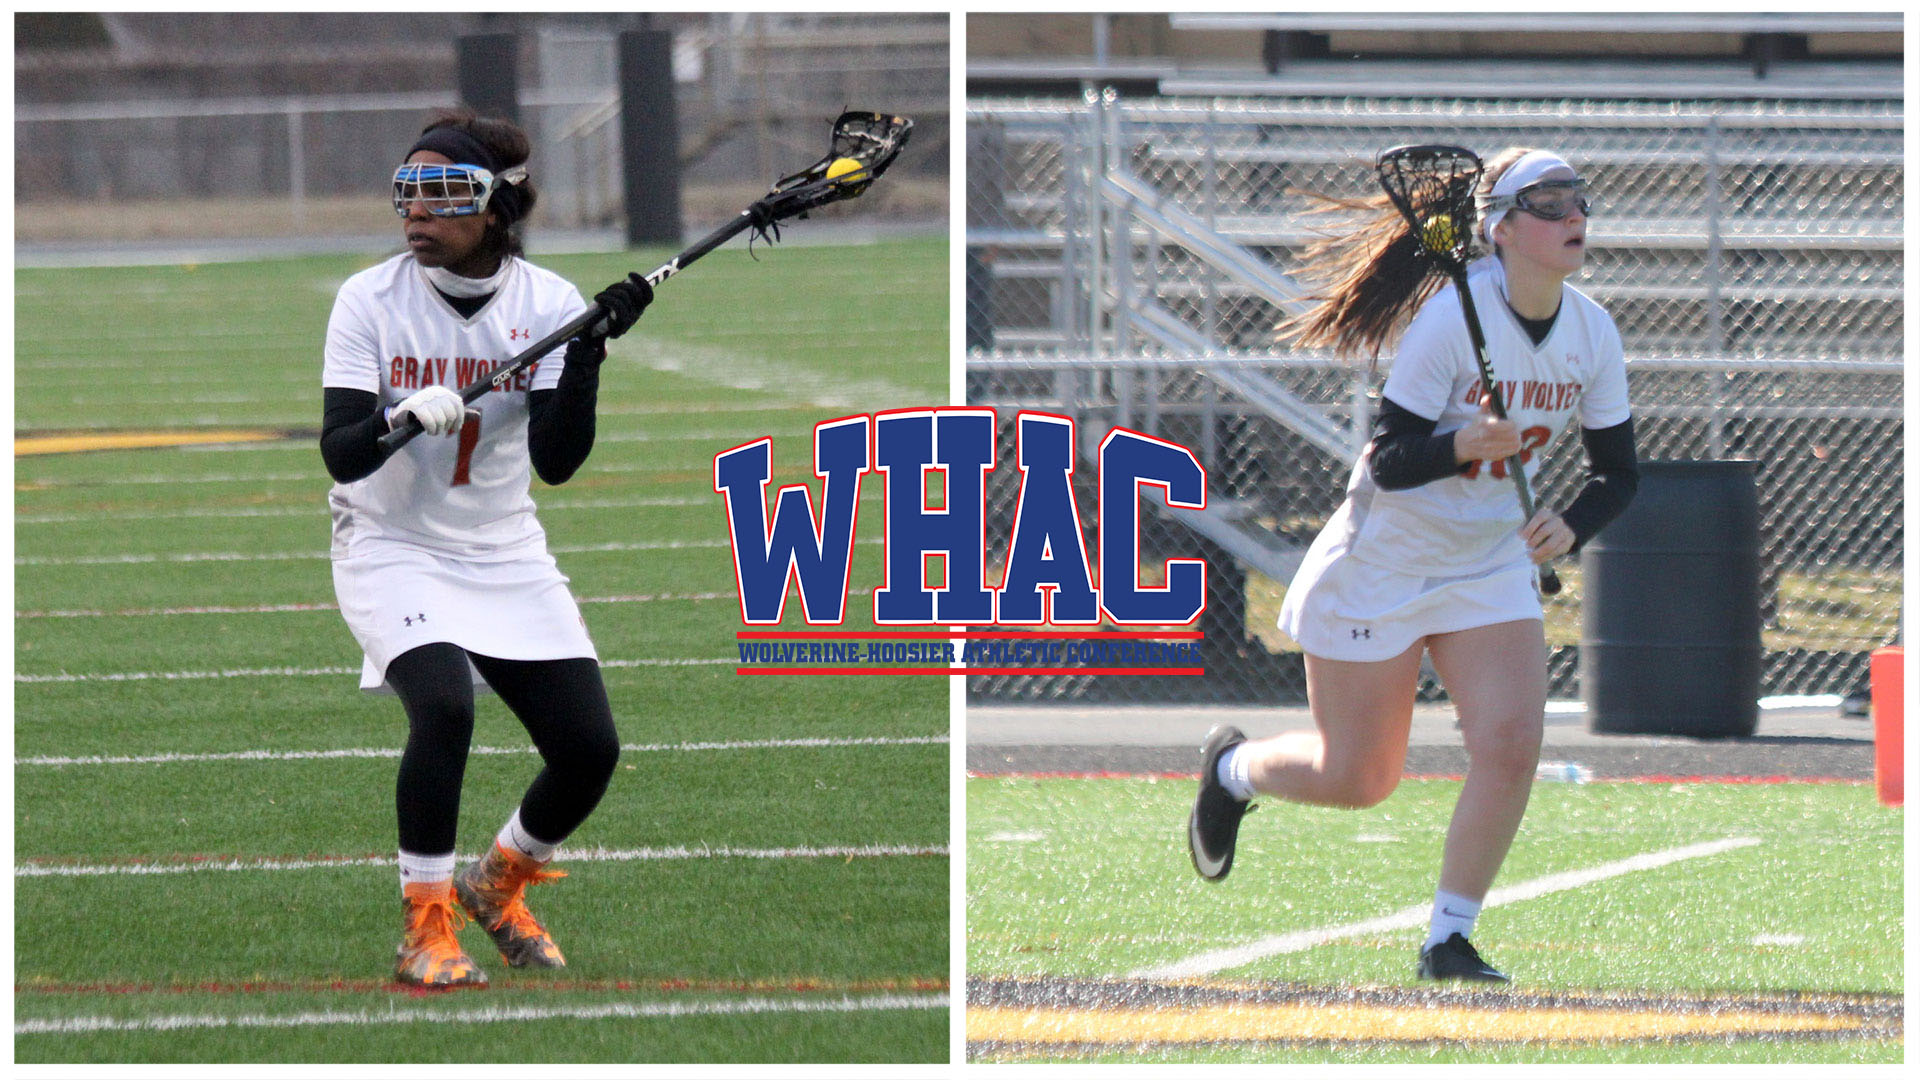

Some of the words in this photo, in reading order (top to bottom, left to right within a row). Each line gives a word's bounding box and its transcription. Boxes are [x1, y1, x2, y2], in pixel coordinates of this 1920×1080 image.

[390, 356, 449, 388] GRAY
[455, 357, 539, 393] WOLE
[1464, 379, 1517, 411] GY
